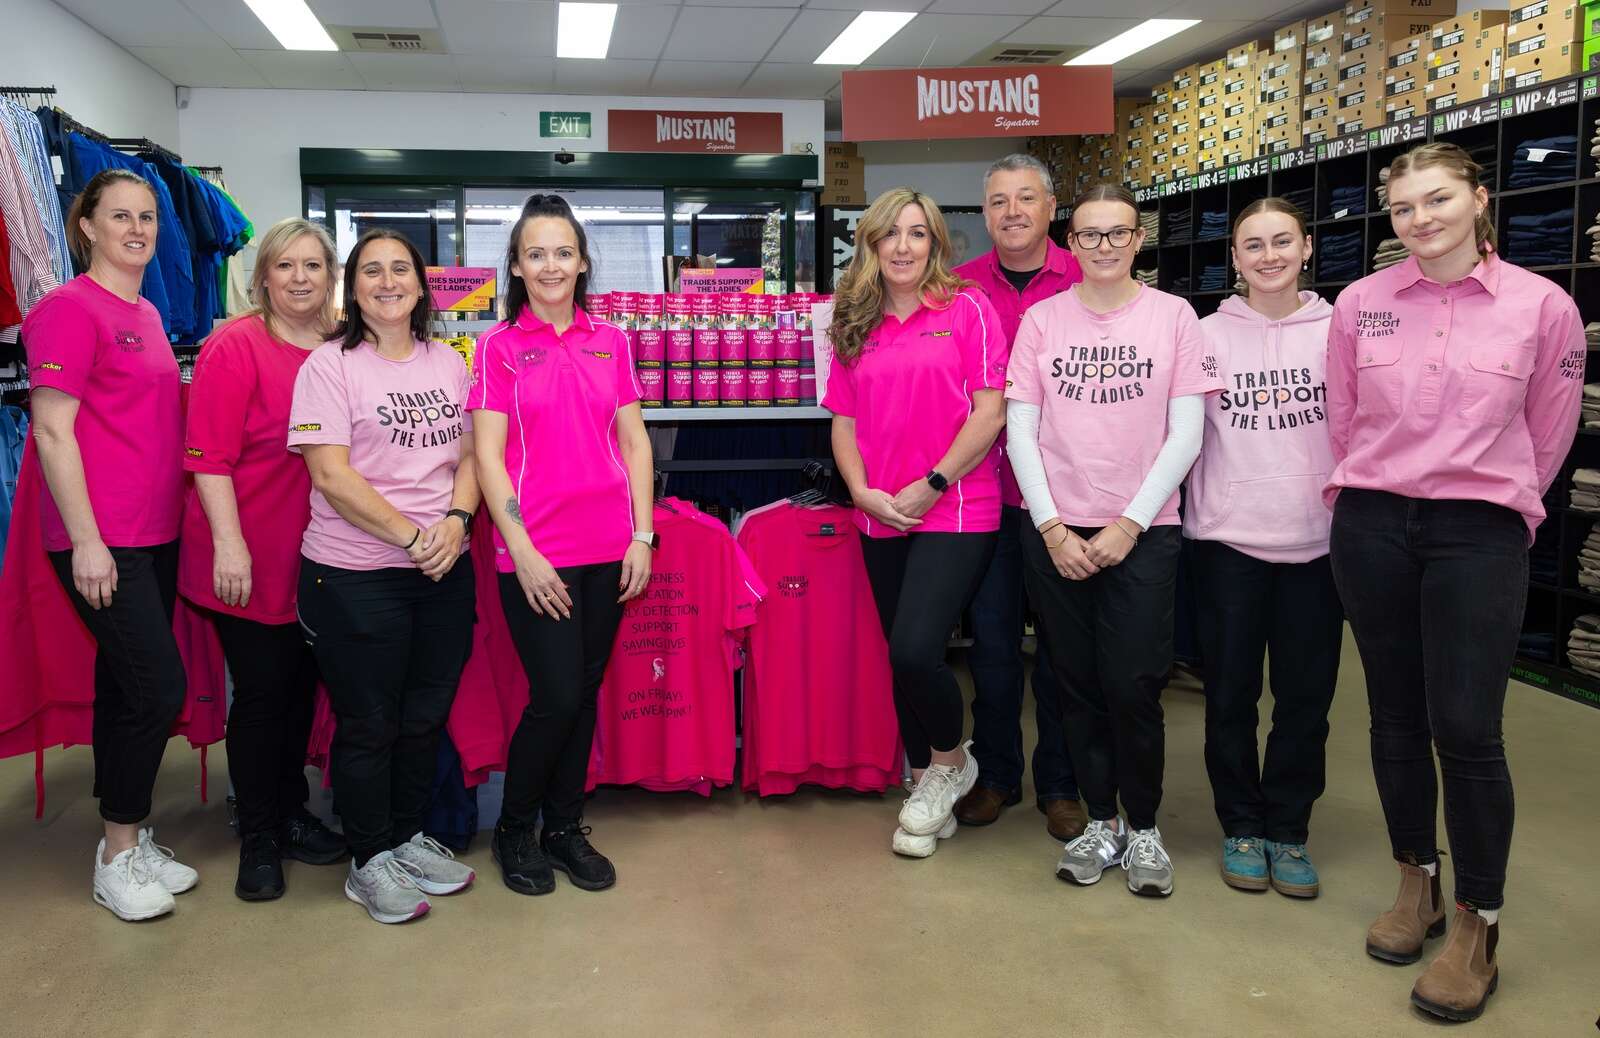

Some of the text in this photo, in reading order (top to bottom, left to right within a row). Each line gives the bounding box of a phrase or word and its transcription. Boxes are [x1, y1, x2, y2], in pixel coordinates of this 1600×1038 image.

[917, 74, 1040, 121] MUSTANG
[1583, 88, 1596, 97] FXD
[550, 116, 581, 134] EXIT
[656, 113, 736, 144] MUSTANG
[994, 116, 1040, 130] Signature
[705, 142, 736, 152] Signature
[718, 278, 755, 286] SUPPORT
[1357, 311, 1393, 320] TRADIES
[1356, 318, 1401, 330] upport
[1367, 328, 1395, 337] LADIES
[1069, 345, 1137, 361] TRADIES
[1051, 357, 1154, 384] Support
[1233, 368, 1312, 390] TRADIES
[387, 388, 450, 408] TRADIES
[1057, 380, 1145, 404] THE LADIES
[1219, 382, 1327, 411] Support
[376, 402, 463, 429] Suppor
[1231, 406, 1325, 431] THE LADIES
[391, 422, 463, 448] THE LADIES
[643, 604, 699, 617] DETECTION
[632, 621, 680, 634] SUPPORT
[622, 638, 664, 651] SAVING
[628, 690, 645, 703] ON
[621, 709, 638, 720] WE
